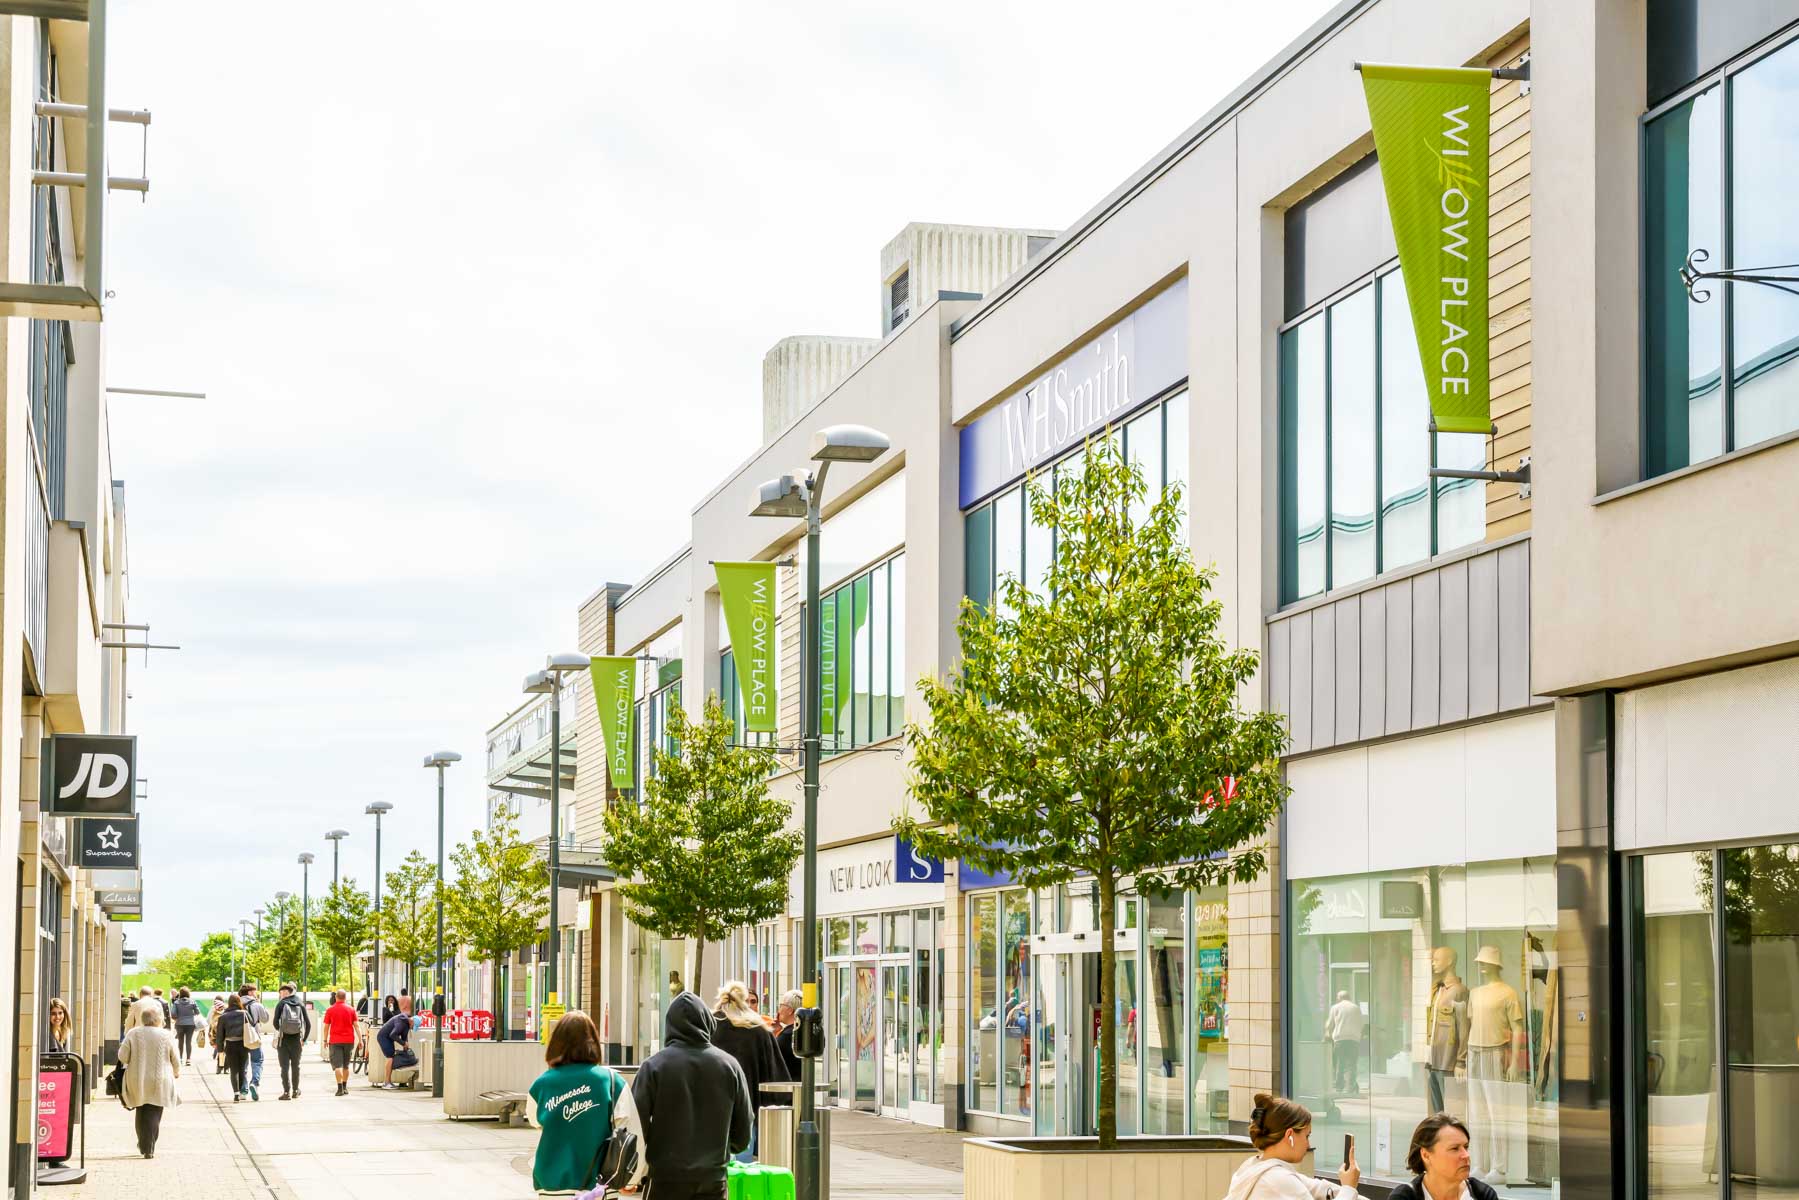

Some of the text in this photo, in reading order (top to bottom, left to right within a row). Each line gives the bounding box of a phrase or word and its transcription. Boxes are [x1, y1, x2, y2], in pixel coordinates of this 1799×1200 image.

[1441, 277, 1470, 395] PLACE
[1003, 328, 1131, 473] WHSmith
[751, 659, 767, 715] PLACE
[615, 731, 627, 776] PLACE
[59, 753, 129, 799] JD
[85, 849, 132, 857] Superdrug
[830, 859, 892, 893] NEW LOOK
[104, 892, 136, 902] Clarks
[545, 1084, 592, 1112] Minnesota
[562, 1099, 593, 1120] College
